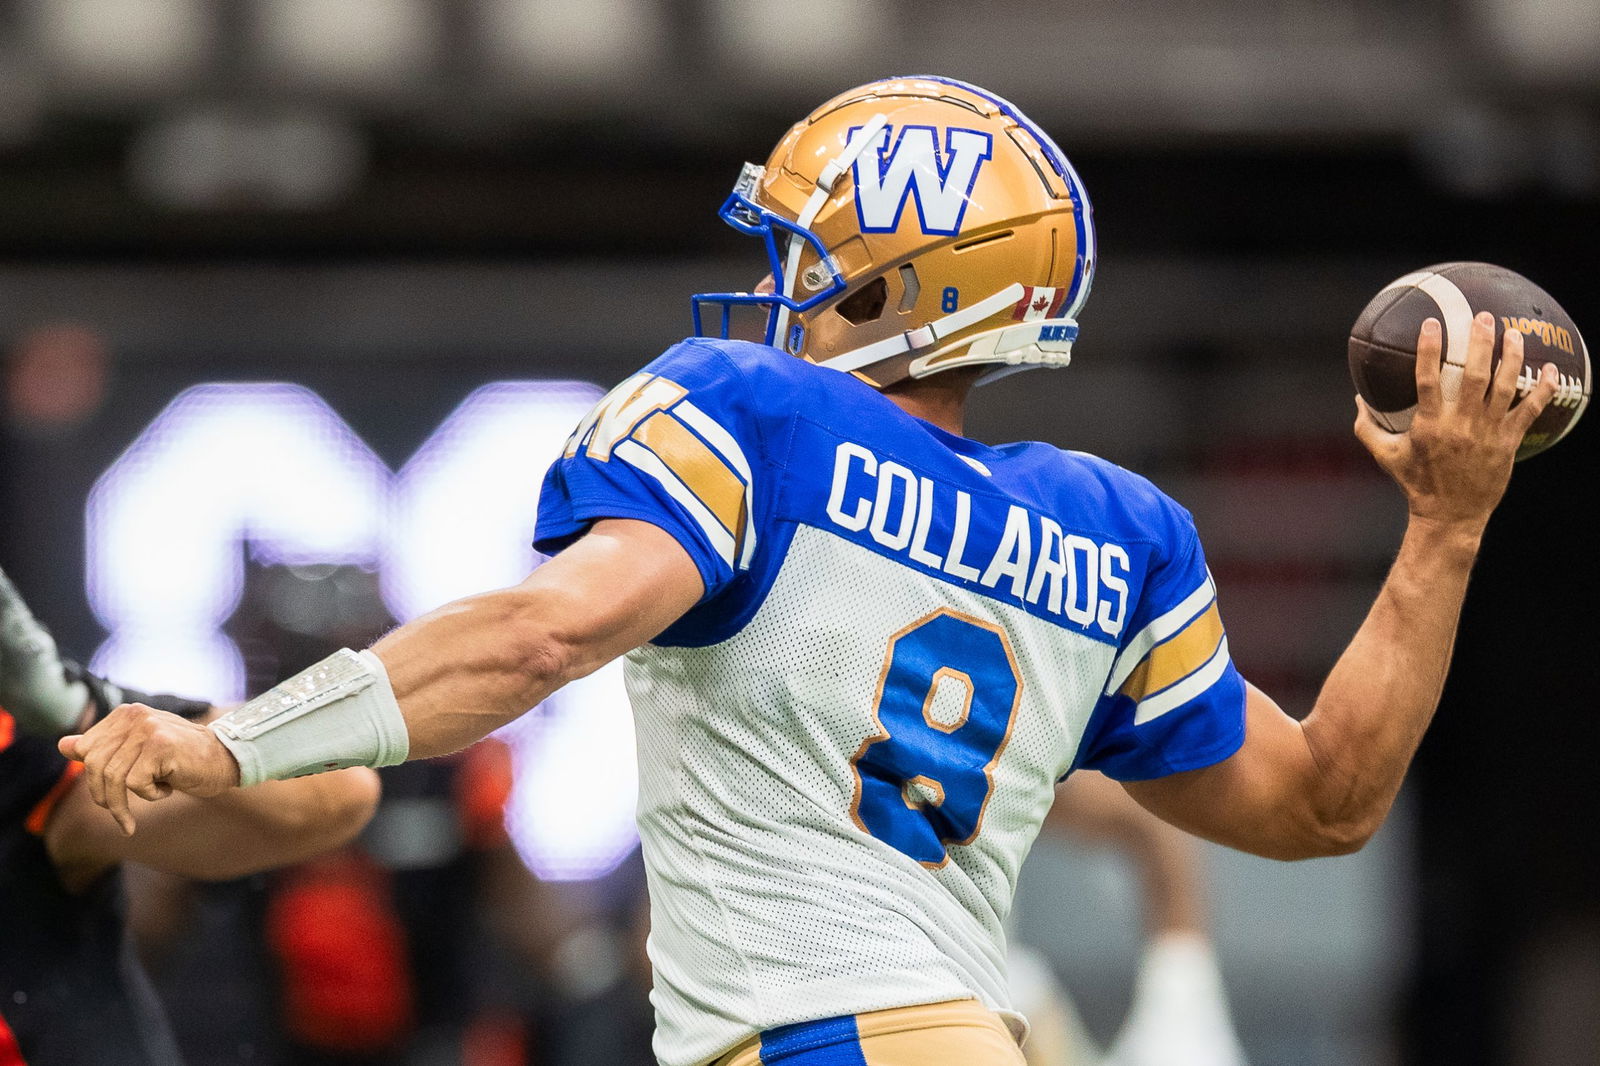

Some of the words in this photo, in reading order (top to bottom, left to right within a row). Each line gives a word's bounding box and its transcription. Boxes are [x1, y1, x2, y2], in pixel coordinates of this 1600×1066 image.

[845, 125, 993, 237] W
[941, 286, 959, 314] 8
[1501, 316, 1575, 356] Wilson
[826, 441, 1130, 636] COLLAROS
[848, 606, 1024, 870] 8
